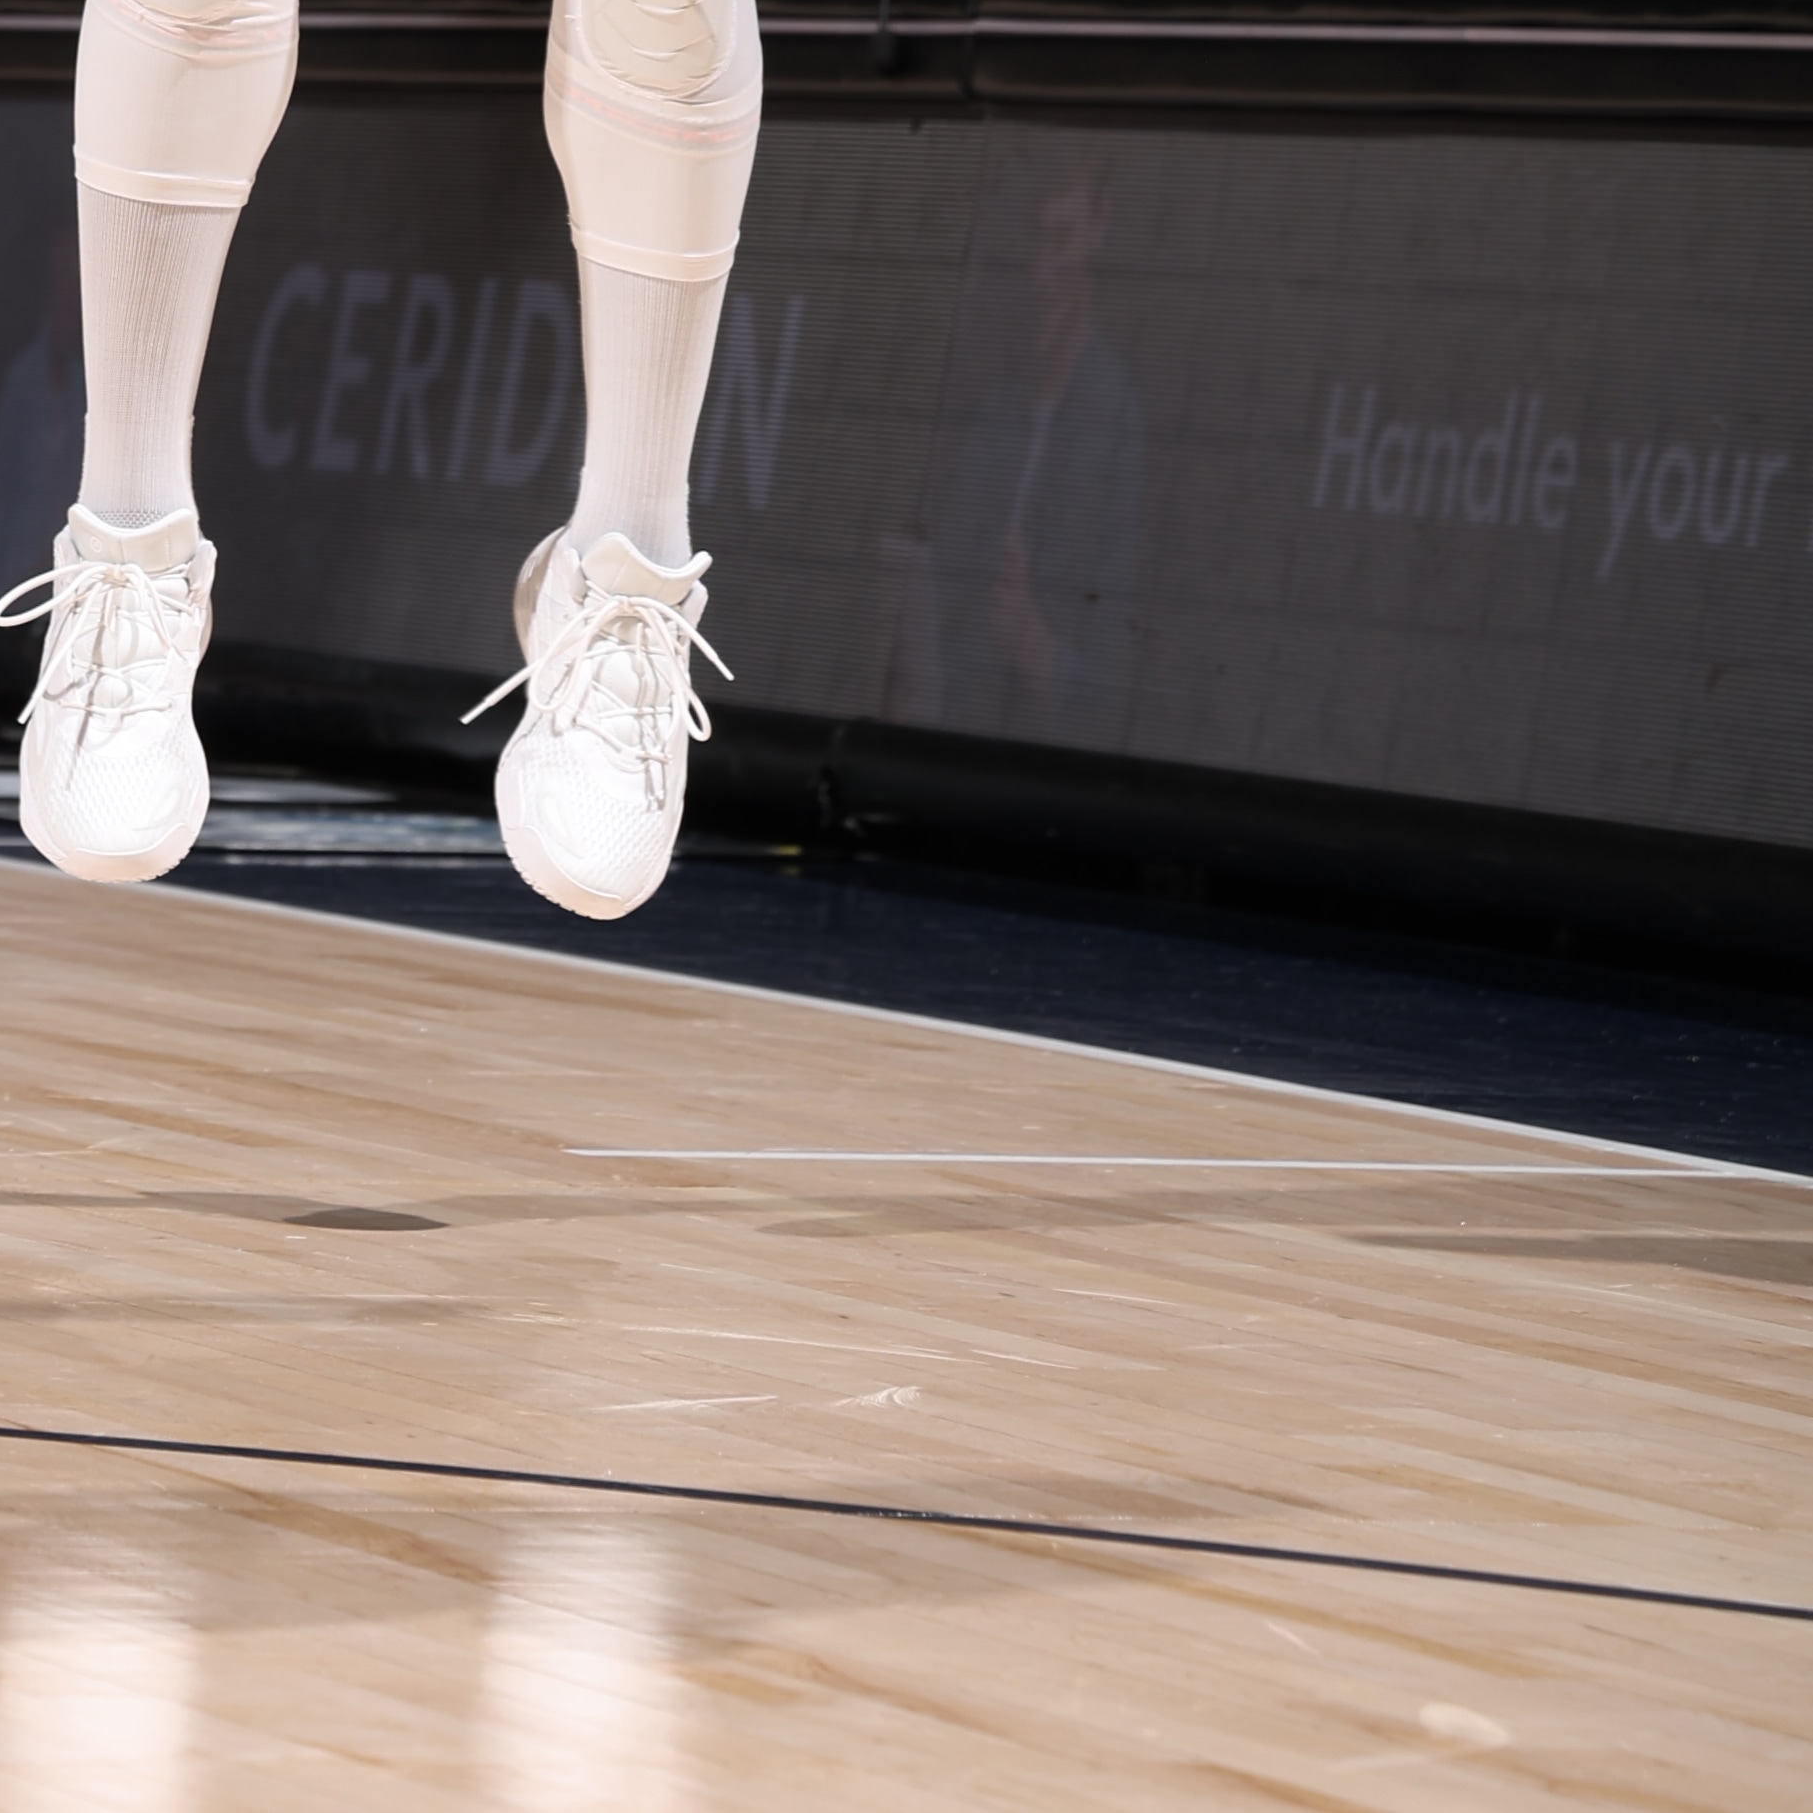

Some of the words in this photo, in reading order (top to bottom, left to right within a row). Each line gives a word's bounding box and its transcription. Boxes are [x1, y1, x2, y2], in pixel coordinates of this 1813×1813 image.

[242, 260, 810, 513] CERIDN
[1310, 384, 1578, 531] Handle
[1596, 433, 1786, 581] your
